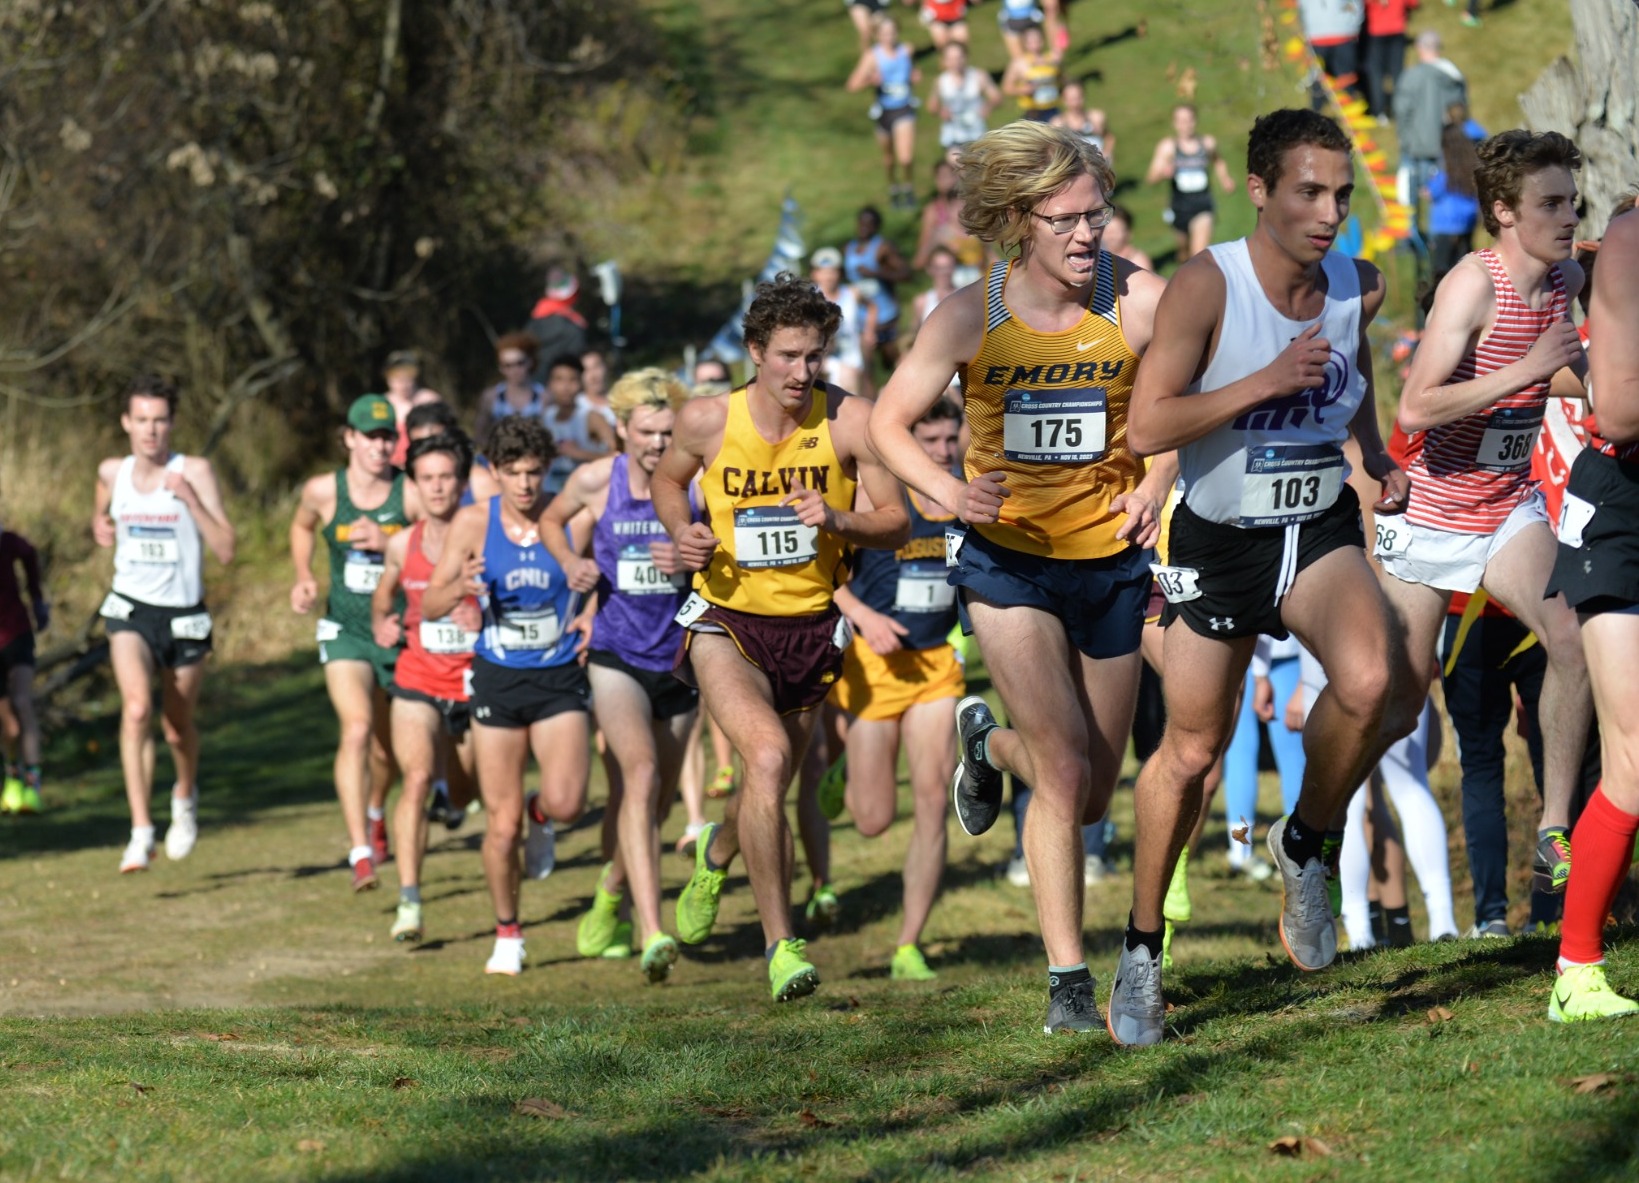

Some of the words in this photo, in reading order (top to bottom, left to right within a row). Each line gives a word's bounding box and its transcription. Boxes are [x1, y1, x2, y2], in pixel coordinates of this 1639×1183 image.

[984, 360, 1126, 385] EMORY
[1031, 418, 1082, 447] 175
[1498, 432, 1533, 461] 368
[1281, 459, 1304, 467] COUNTRY
[723, 465, 829, 498] CALVIN
[1271, 476, 1321, 510] 103
[757, 530, 798, 556] 115
[1376, 524, 1397, 551] 68
[505, 567, 550, 591] CNU
[1158, 571, 1184, 595] 03
[927, 585, 934, 603] 1
[679, 599, 697, 616] 5
